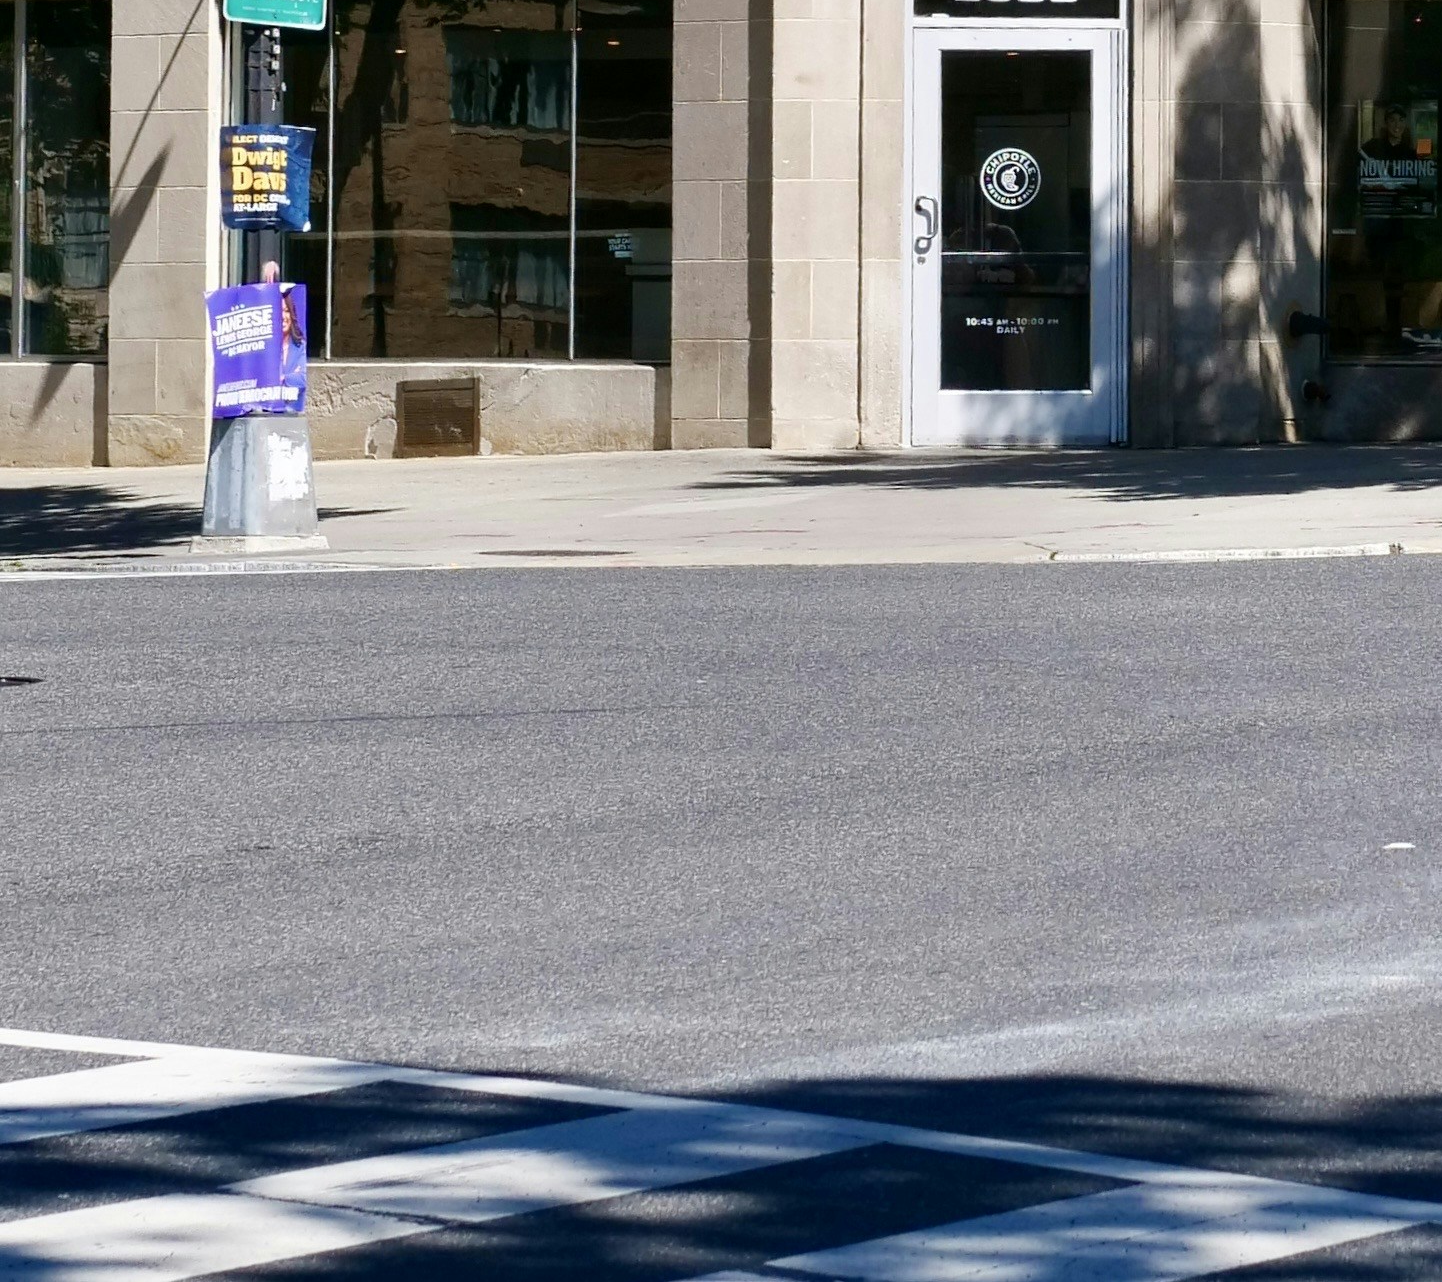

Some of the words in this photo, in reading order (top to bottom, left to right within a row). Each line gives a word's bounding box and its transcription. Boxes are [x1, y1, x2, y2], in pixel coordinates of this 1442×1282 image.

[986, 152, 1036, 175] CHIPOTLE
[1360, 159, 1390, 176] NOW
[1393, 159, 1435, 176] HIRING
[233, 194, 252, 203] FOR
[253, 194, 268, 203] DC
[212, 307, 273, 337] JANEESE
[996, 326, 1026, 334] DAILY
[236, 324, 273, 340] GEORGE
